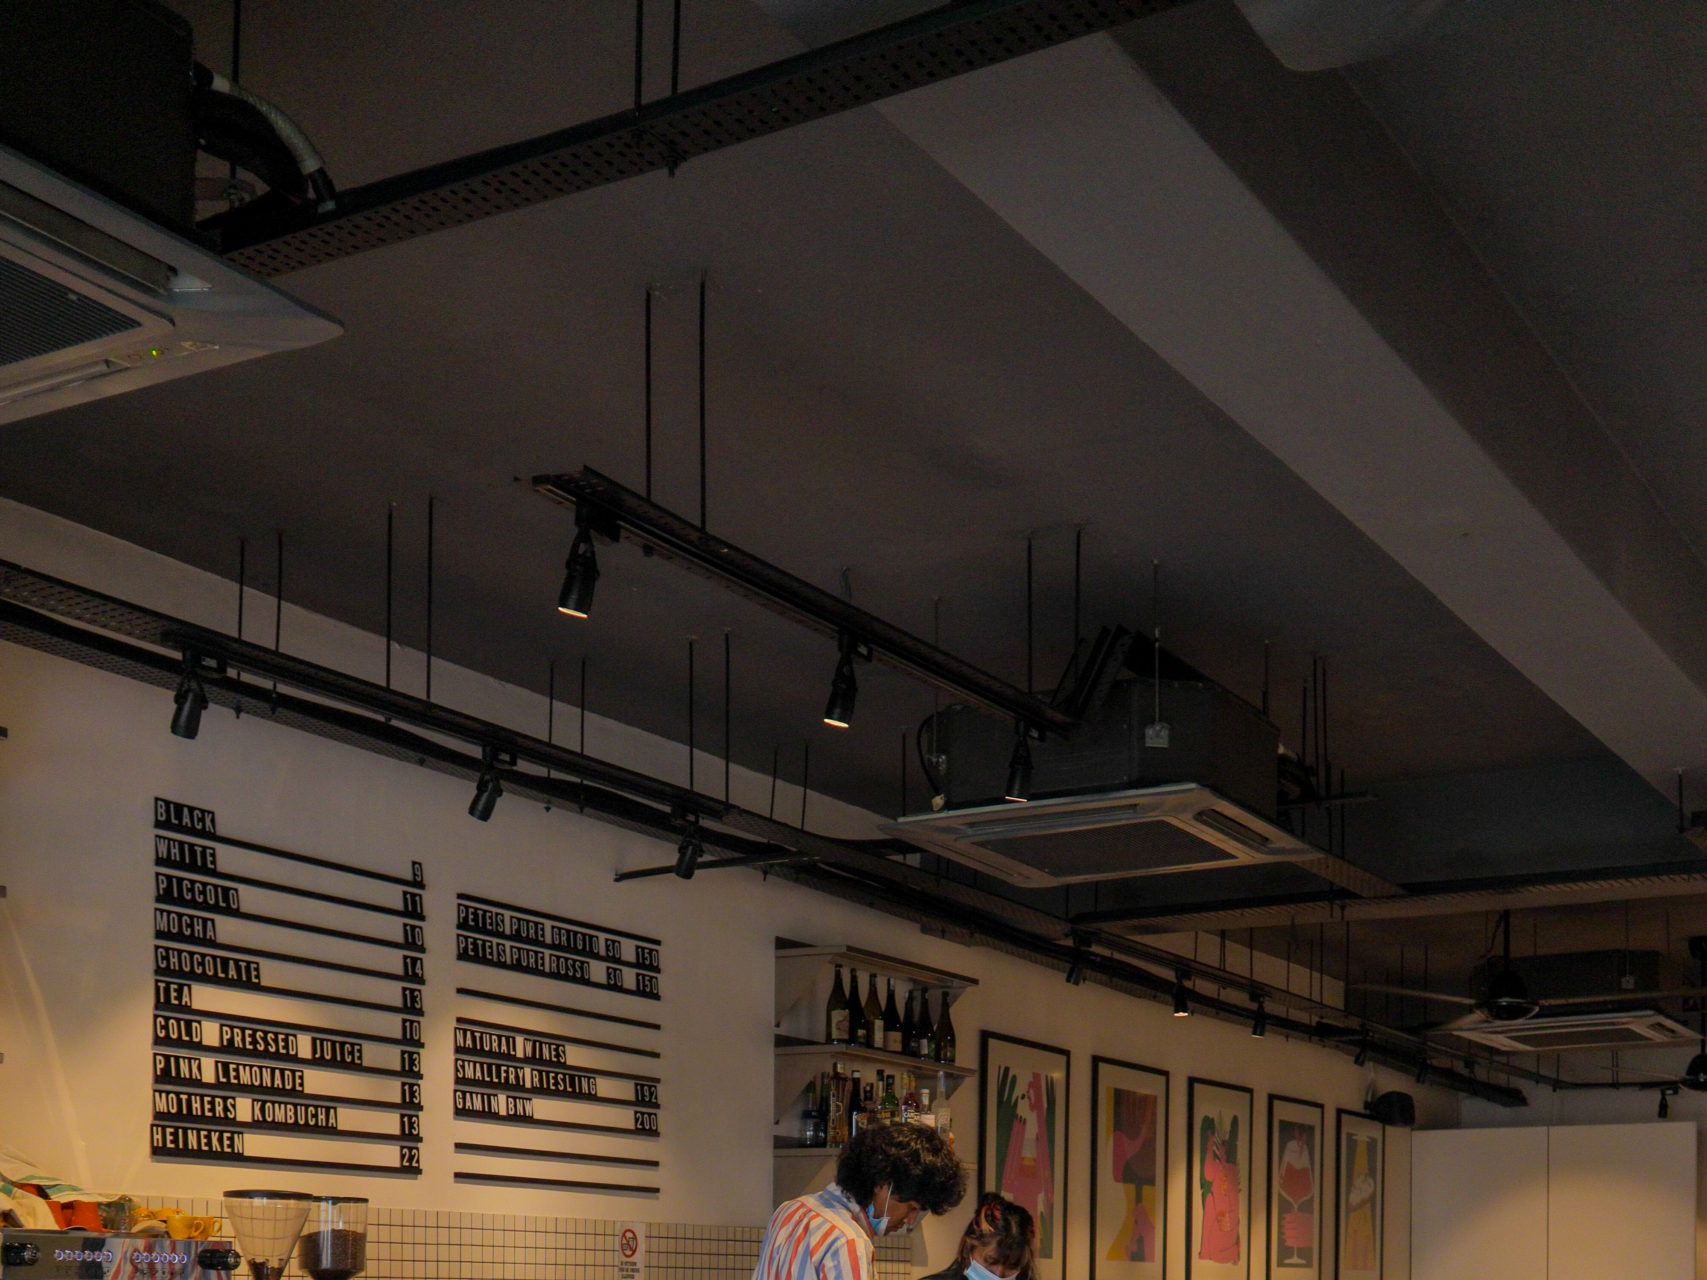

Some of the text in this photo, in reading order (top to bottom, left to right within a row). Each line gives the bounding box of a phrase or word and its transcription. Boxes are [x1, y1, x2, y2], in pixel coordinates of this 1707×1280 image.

[156, 800, 422, 882] BLACK 9
[155, 838, 422, 913] WHITE 11
[158, 875, 423, 945] PICCOLO 10
[155, 911, 423, 977] MOCHA 14
[512, 918, 544, 941] PURE
[552, 929, 599, 953] GRIGIO
[606, 940, 621, 958] 30
[638, 948, 658, 967] 150
[157, 948, 422, 1009] CHOCOLATE 13
[512, 948, 544, 970] PURE
[550, 957, 590, 979] ROSSO
[608, 968, 622, 986] 30
[638, 975, 658, 994] 150
[157, 982, 421, 1041] TEA 10
[156, 1017, 420, 1072] COLD PRESSED JUICE 13
[455, 1029, 565, 1062] NATURAL WINES
[156, 1056, 420, 1104] PINK LEMONADE 13
[456, 1060, 657, 1102] SMALLFRY RIESLING 192
[155, 1092, 419, 1135] MOTHERS KOMBUCHA 13
[455, 1092, 657, 1130] GAMIN BNW 200
[152, 1127, 419, 1167] HEINEKEN 22
